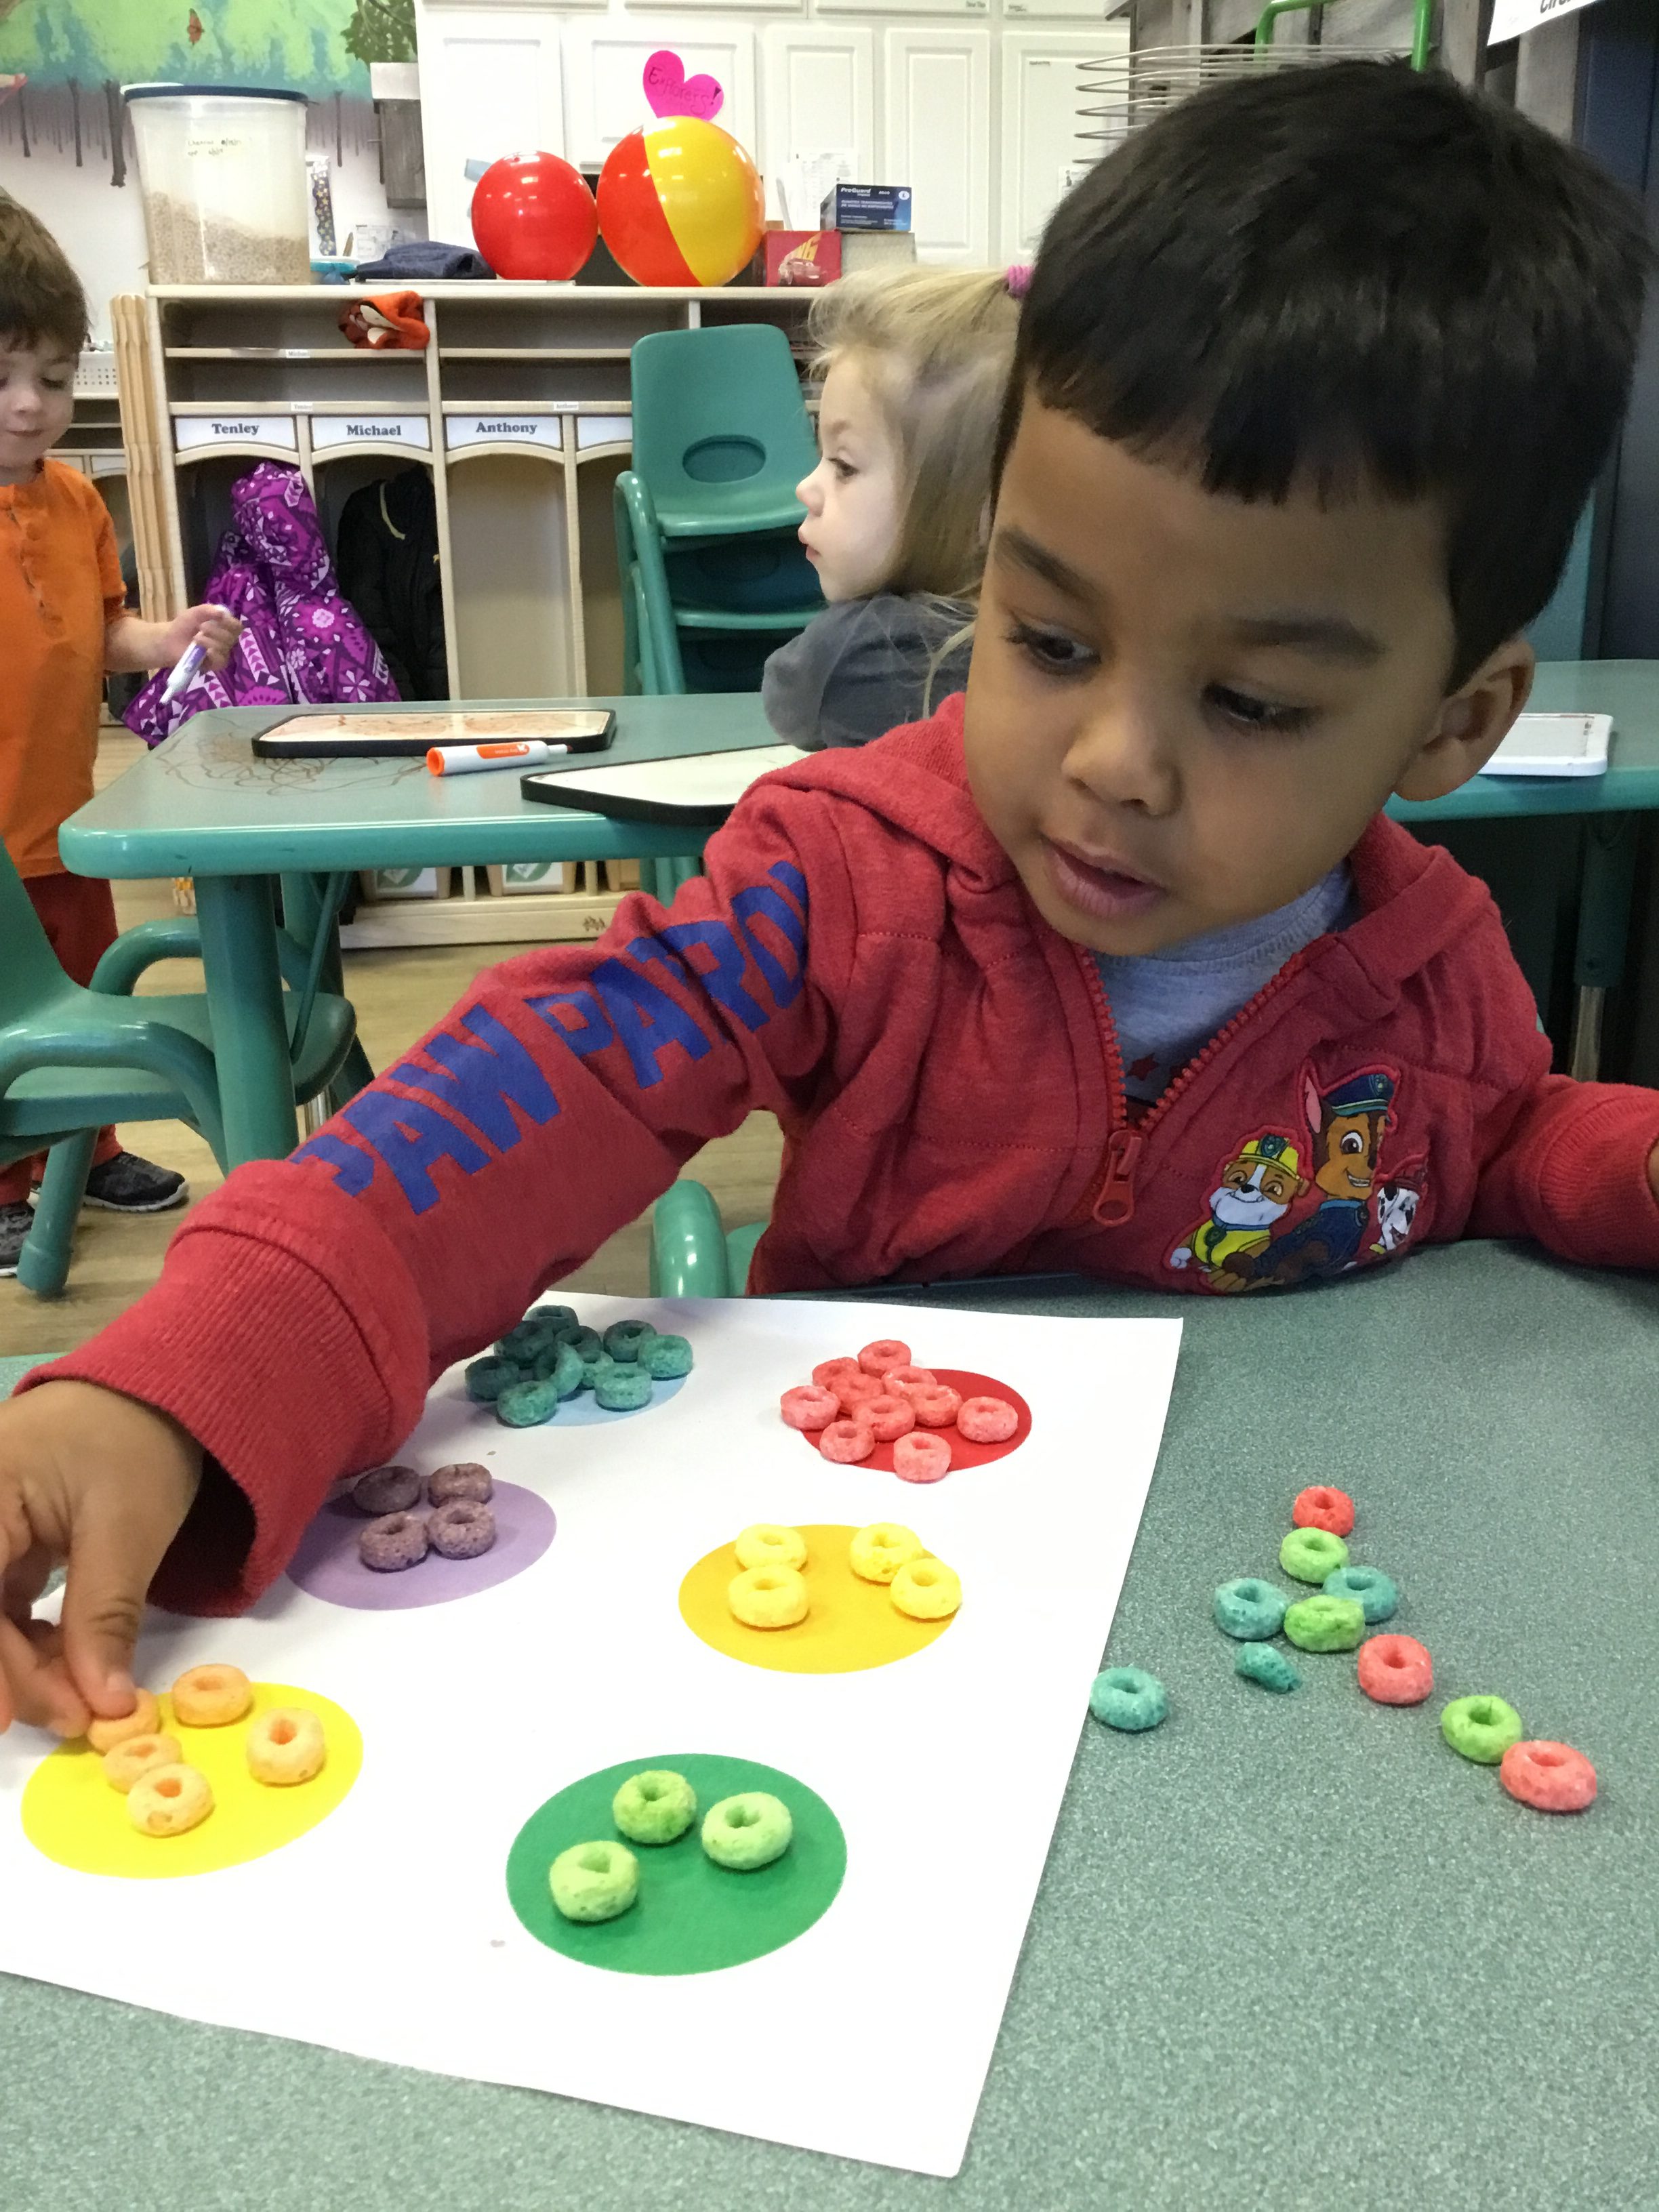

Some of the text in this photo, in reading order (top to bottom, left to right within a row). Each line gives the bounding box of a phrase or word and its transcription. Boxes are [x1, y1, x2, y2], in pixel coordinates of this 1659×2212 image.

[211, 423, 260, 436] Tenley
[346, 424, 401, 436] Michael
[476, 422, 537, 434] Anthony
